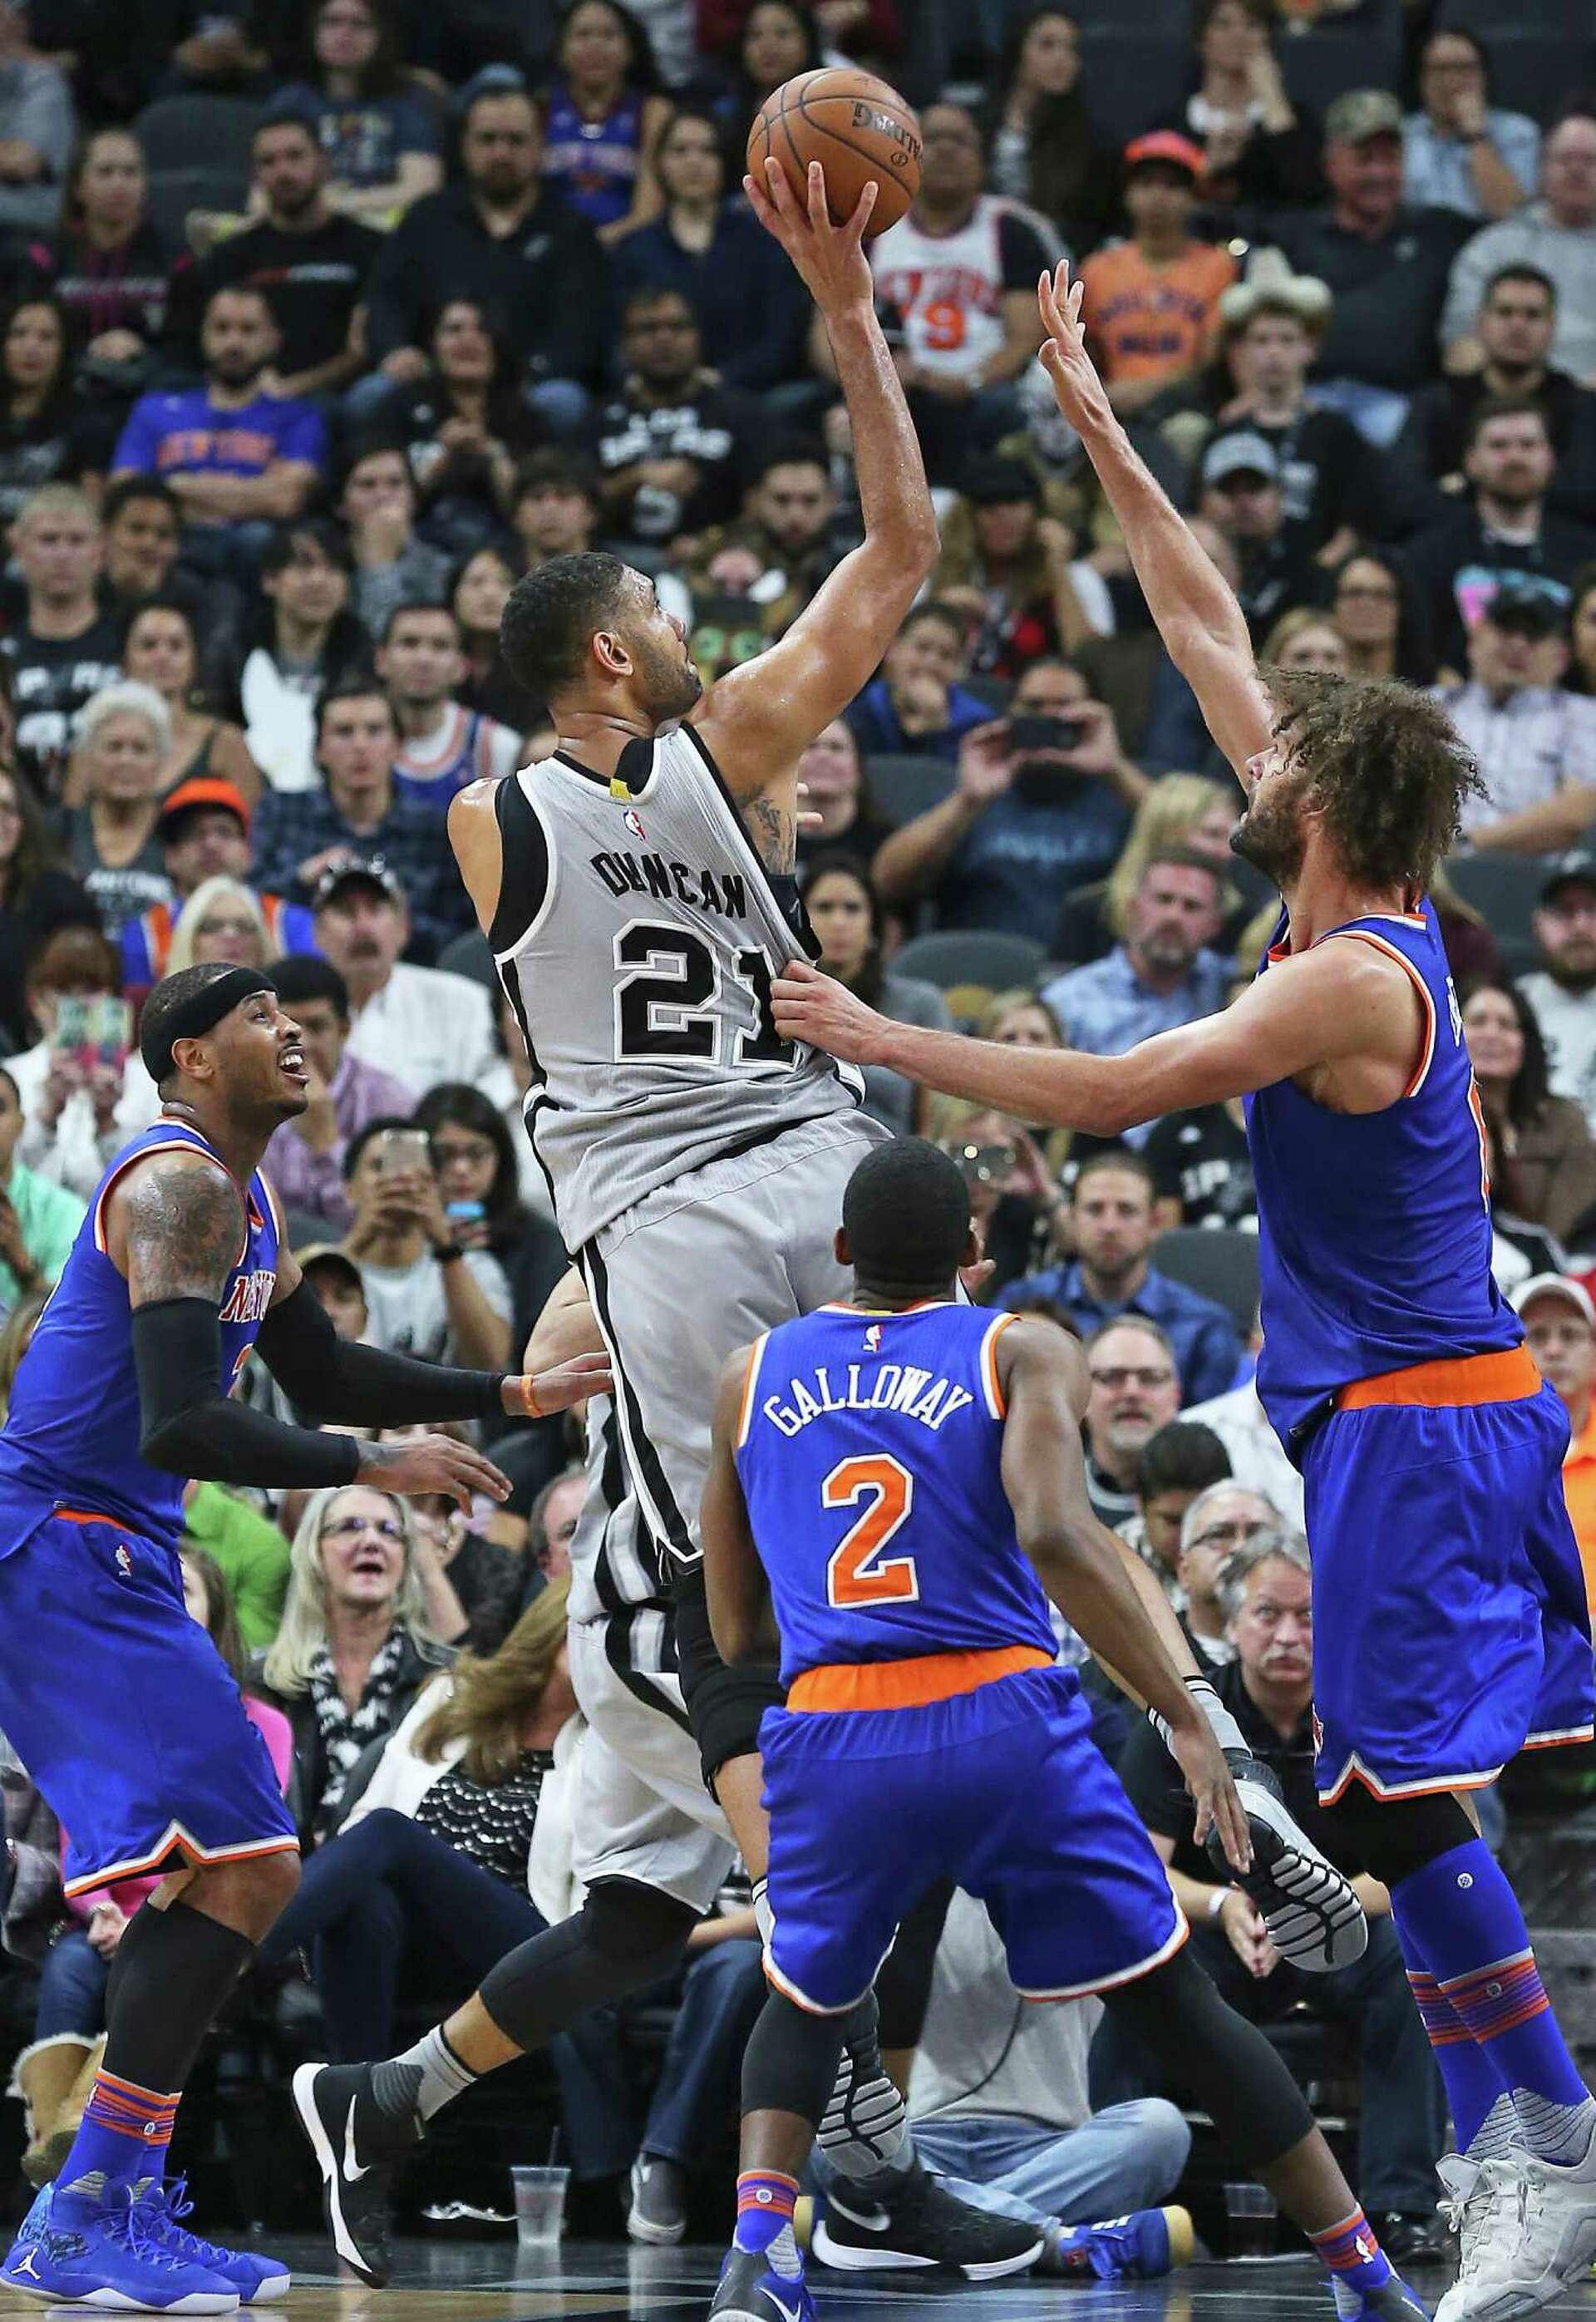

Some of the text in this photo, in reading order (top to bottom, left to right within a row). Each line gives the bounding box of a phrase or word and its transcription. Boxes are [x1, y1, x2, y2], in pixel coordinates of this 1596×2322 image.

[851, 100, 923, 160] ALDING
[924, 299, 965, 352] 9
[589, 851, 747, 919] DUNCAN
[612, 917, 801, 1073] 21
[762, 1364, 974, 1437] GALLOWAY
[821, 1452, 920, 1610] 2
